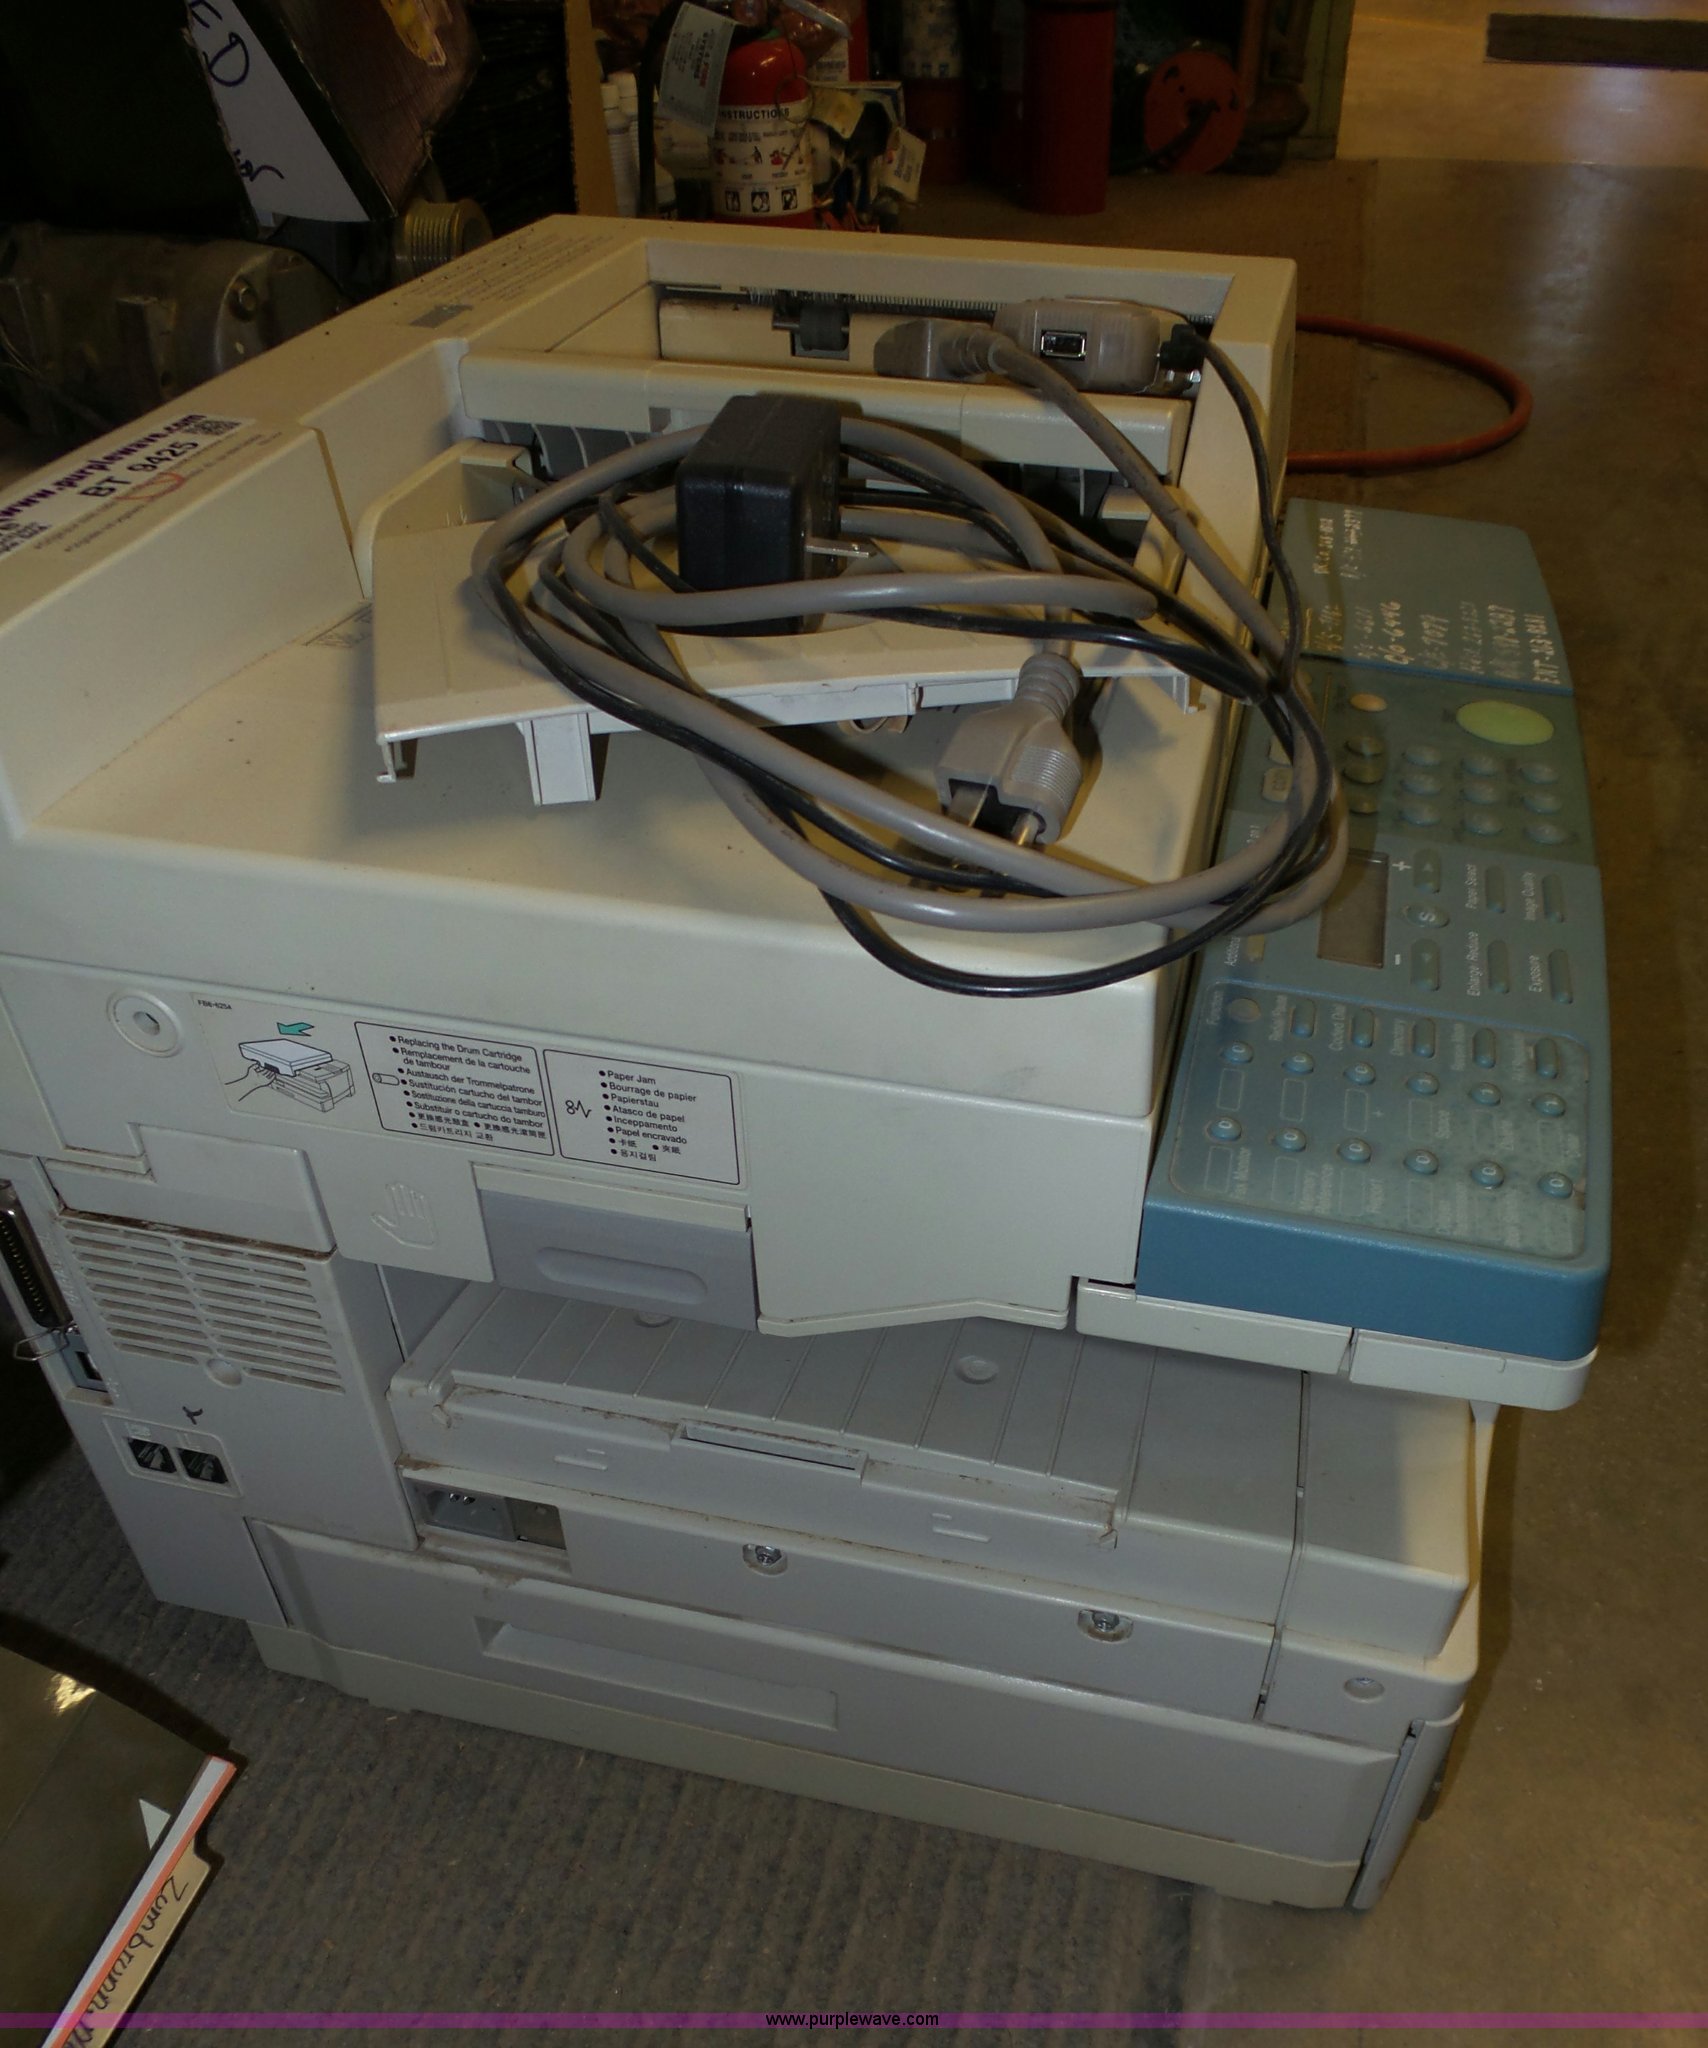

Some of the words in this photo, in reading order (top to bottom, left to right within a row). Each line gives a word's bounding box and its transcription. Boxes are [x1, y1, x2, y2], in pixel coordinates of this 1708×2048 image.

[78, 475, 132, 498] BT
[127, 440, 199, 473] 9425
[397, 1036, 440, 1051] Replacing
[441, 1042, 456, 1052] the
[457, 1044, 481, 1056] Drum
[482, 1047, 522, 1062] Cartridge
[401, 1047, 463, 1064] Remplacement
[465, 1057, 477, 1066] de
[487, 1061, 531, 1074] cartouche
[403, 1057, 415, 1066] de
[415, 1060, 450, 1071] tambour
[406, 1068, 450, 1082] Austausch
[451, 1076, 465, 1084] der
[465, 1076, 536, 1096] Trommelpatrone
[607, 1070, 635, 1082] Paper
[636, 1074, 657, 1085] Jam
[409, 1079, 457, 1094] Sustitución
[459, 1088, 496, 1100] cartucho
[497, 1093, 510, 1102] del
[511, 1096, 543, 1107] tambor
[609, 1081, 652, 1097] Bourrage
[653, 1089, 665, 1098] de
[667, 1092, 697, 1103] papier
[611, 1092, 660, 1108] Papierstau
[414, 1101, 453, 1114] Substituir
[462, 1110, 499, 1122] cartucho
[500, 1115, 512, 1124] do
[512, 1118, 543, 1129] tambor
[459, 1098, 477, 1108] della
[477, 1101, 512, 1113] cartuccia
[512, 1105, 547, 1119] tamburo
[613, 1104, 644, 1117] Atasco
[646, 1110, 658, 1119] de
[660, 1113, 686, 1123] papel
[614, 1115, 678, 1133] Inceppamento
[615, 1126, 641, 1137] Papel
[642, 1131, 688, 1145] encravado
